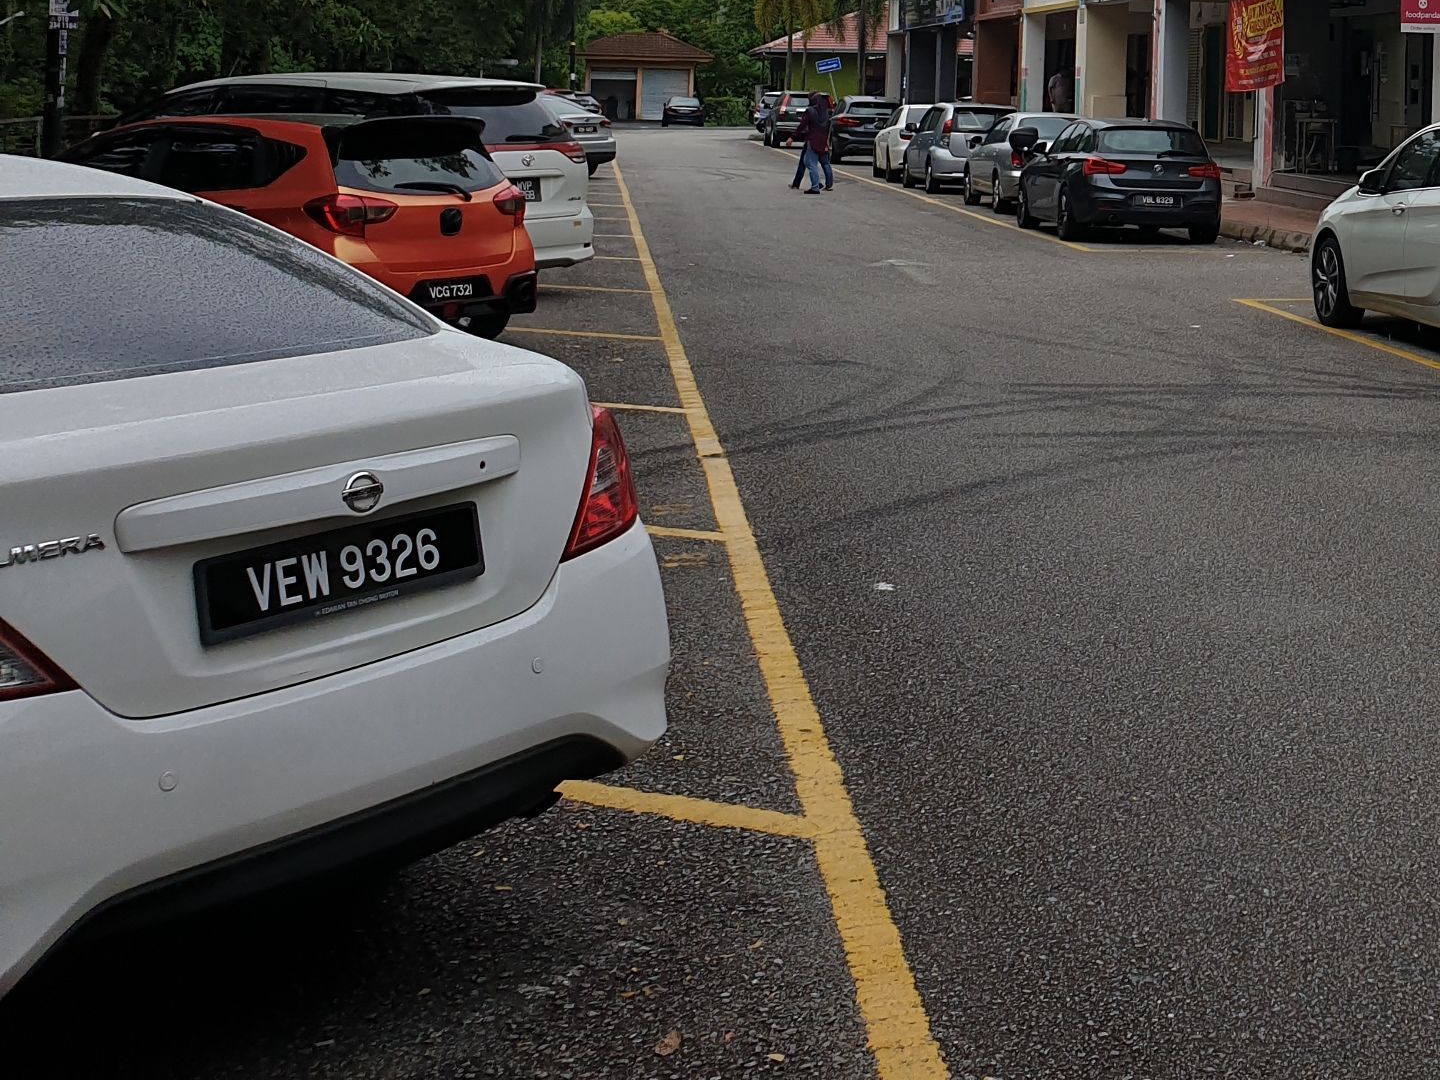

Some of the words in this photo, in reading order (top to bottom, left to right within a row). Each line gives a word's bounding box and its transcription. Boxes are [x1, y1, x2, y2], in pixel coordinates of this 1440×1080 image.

[1405, 10, 1440, 20] foodpanda
[1142, 196, 1155, 204] VBL
[429, 286, 450, 299] VCG
[450, 283, 473, 297] 7321
[0, 533, 106, 568] MERA
[246, 550, 331, 612] VEW
[340, 528, 441, 589] 9326
[321, 603, 346, 615] EDARAN
[346, 600, 358, 608] TAN
[358, 594, 379, 605] CHONG
[379, 589, 399, 600] MOTOR
